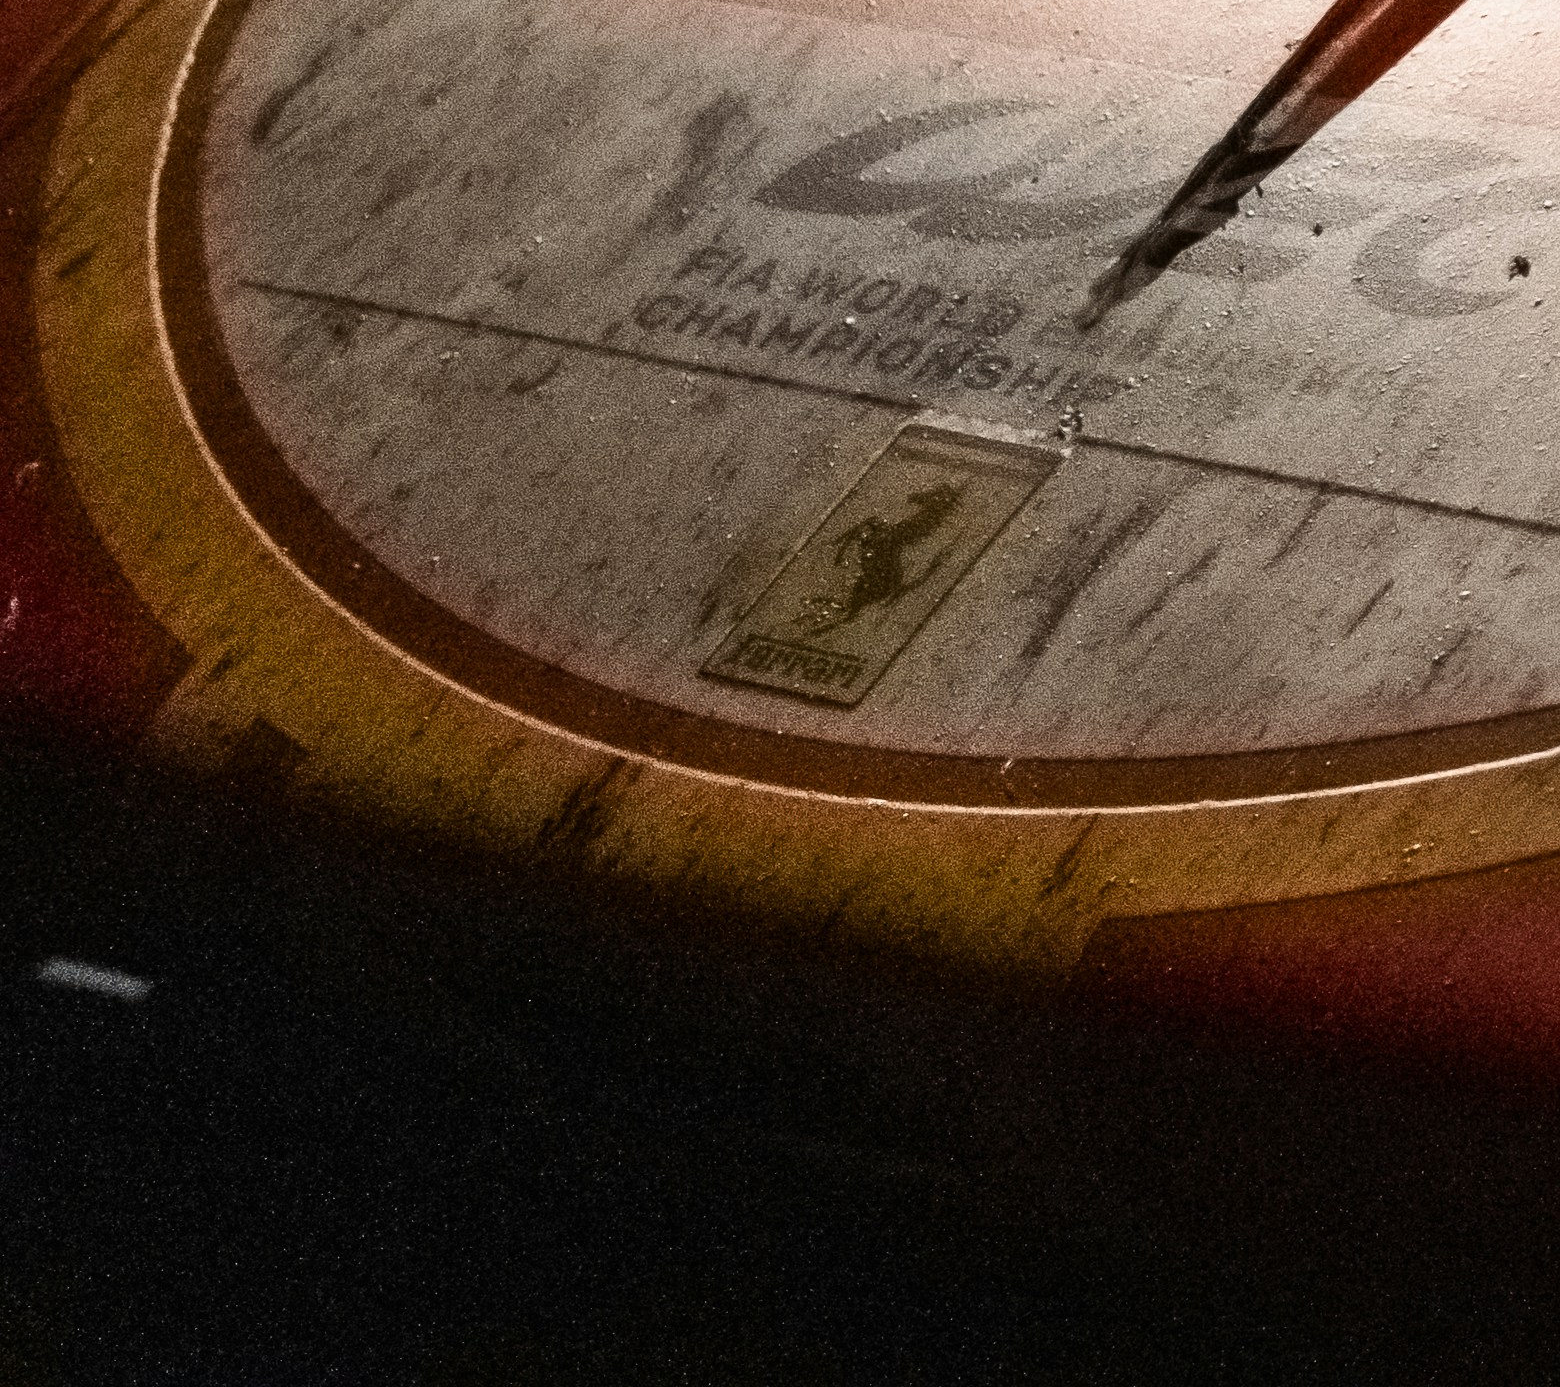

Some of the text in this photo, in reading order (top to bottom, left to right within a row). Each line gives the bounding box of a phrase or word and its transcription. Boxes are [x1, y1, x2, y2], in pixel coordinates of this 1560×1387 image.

[672, 241, 1024, 339] FIA WORLD
[632, 290, 1126, 409] CHAMPIONSHIP
